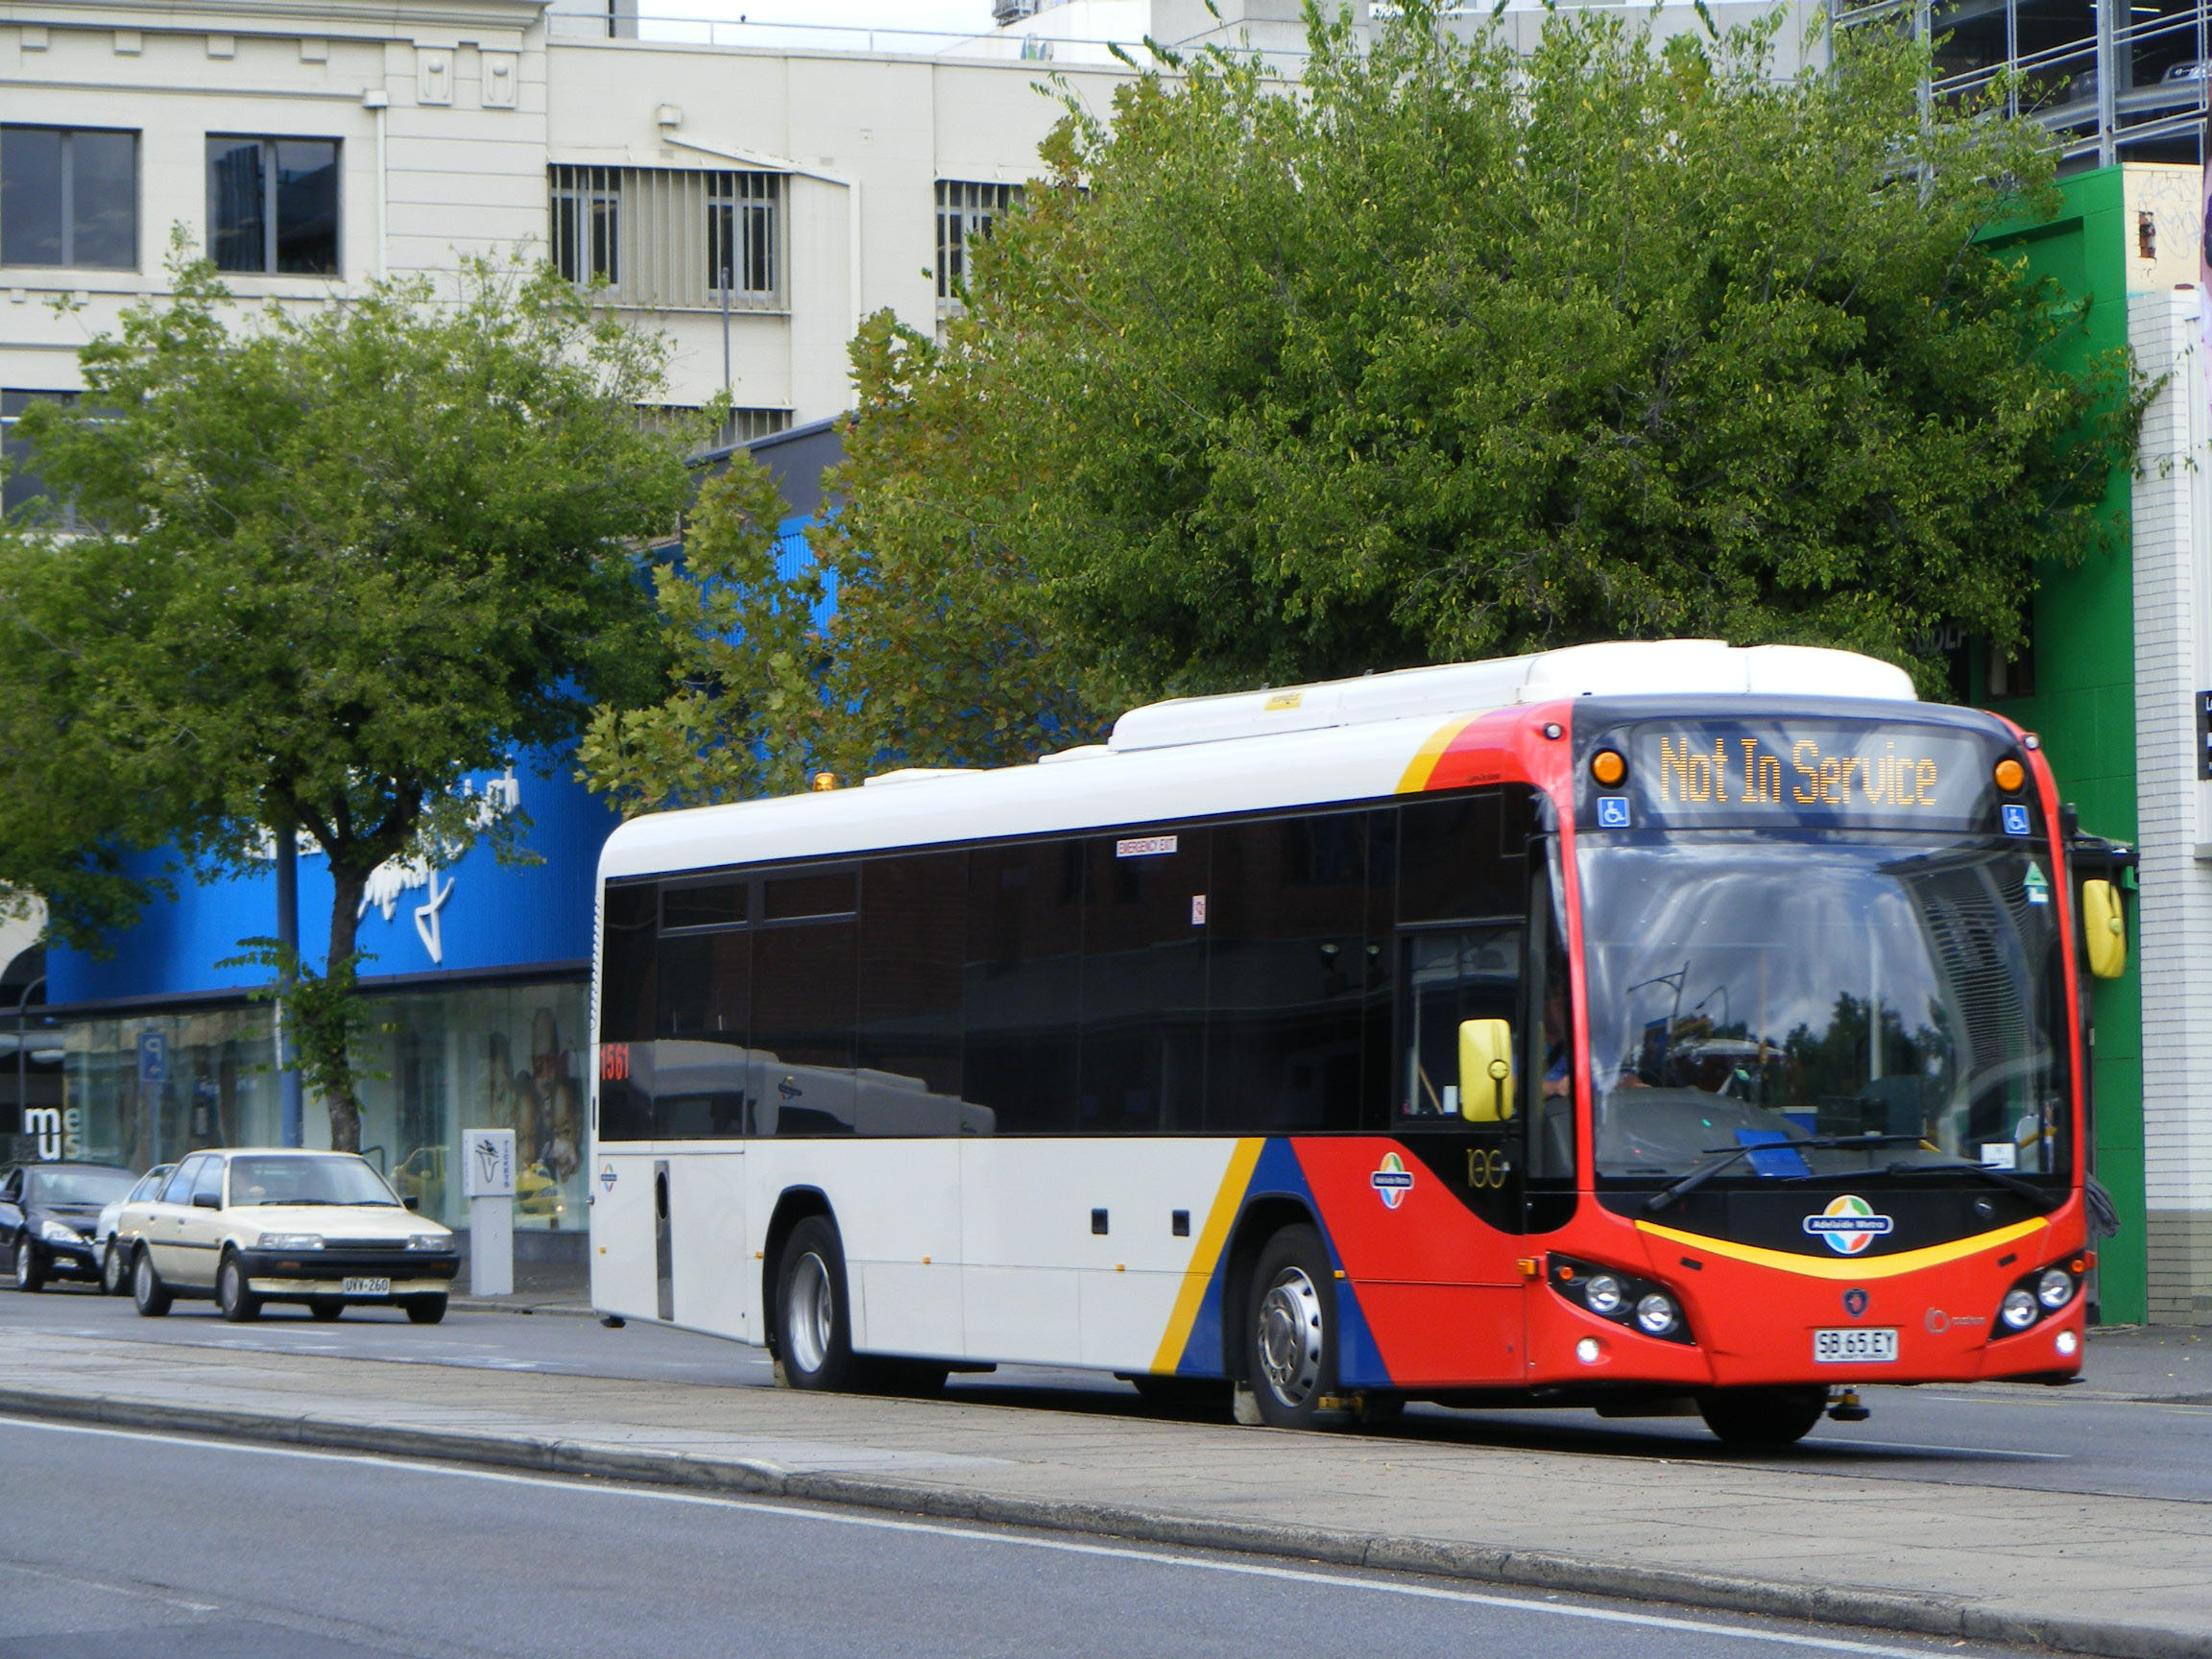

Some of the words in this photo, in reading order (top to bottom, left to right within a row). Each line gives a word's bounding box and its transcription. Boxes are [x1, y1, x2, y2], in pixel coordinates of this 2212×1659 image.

[1661, 736, 1728, 803] Not
[1741, 738, 1781, 804] In
[1792, 739, 1937, 805] Service
[1119, 840, 1157, 854] EMERGENCY
[1160, 838, 1174, 852] EXIT
[600, 1044, 630, 1081] 1561
[1818, 1333, 1840, 1354] SB
[1845, 1333, 1866, 1354] 65
[1873, 1332, 1895, 1353] EY
